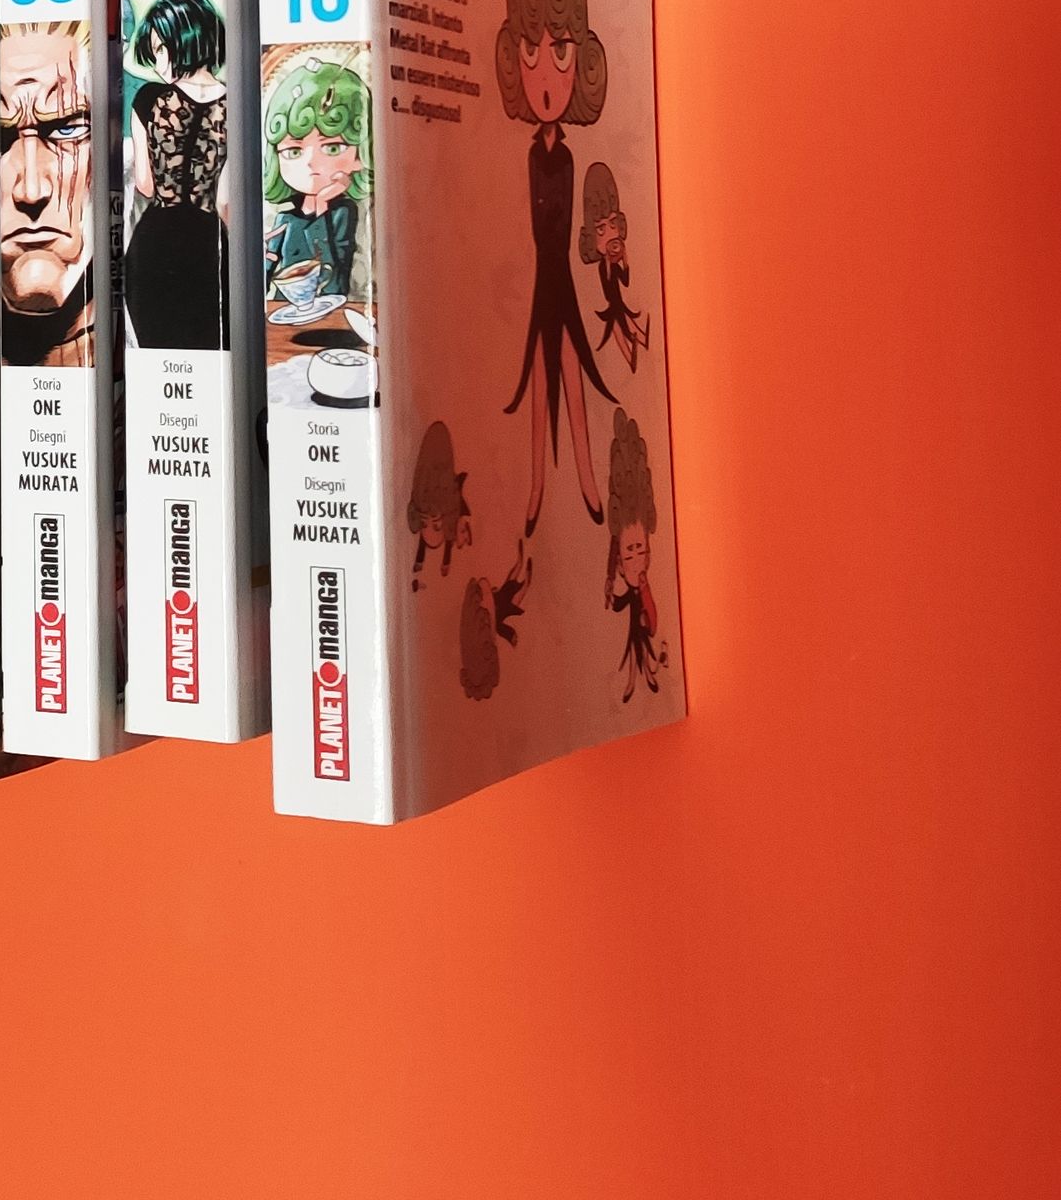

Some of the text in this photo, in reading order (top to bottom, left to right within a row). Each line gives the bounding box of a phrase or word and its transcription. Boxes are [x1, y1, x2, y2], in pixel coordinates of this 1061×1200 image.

[164, 360, 192, 373] Storia
[33, 378, 61, 390] Storia
[164, 383, 193, 399] ONE
[33, 399, 61, 415] ONE
[160, 413, 197, 430] Disegni
[308, 422, 339, 435] Storia
[30, 429, 65, 446] Disegni
[152, 436, 209, 454] YUSUKE
[22, 451, 76, 469] YUSUKE
[308, 445, 340, 463] ONE
[148, 458, 211, 477] MURATA
[19, 474, 78, 492] MURATA
[305, 477, 345, 495] Disegni
[297, 500, 358, 520] YUSUKE
[293, 524, 360, 544] MURATA
[172, 614, 194, 700] PLANET
[40, 626, 61, 710] PLANET
[320, 687, 344, 778] PLANET
